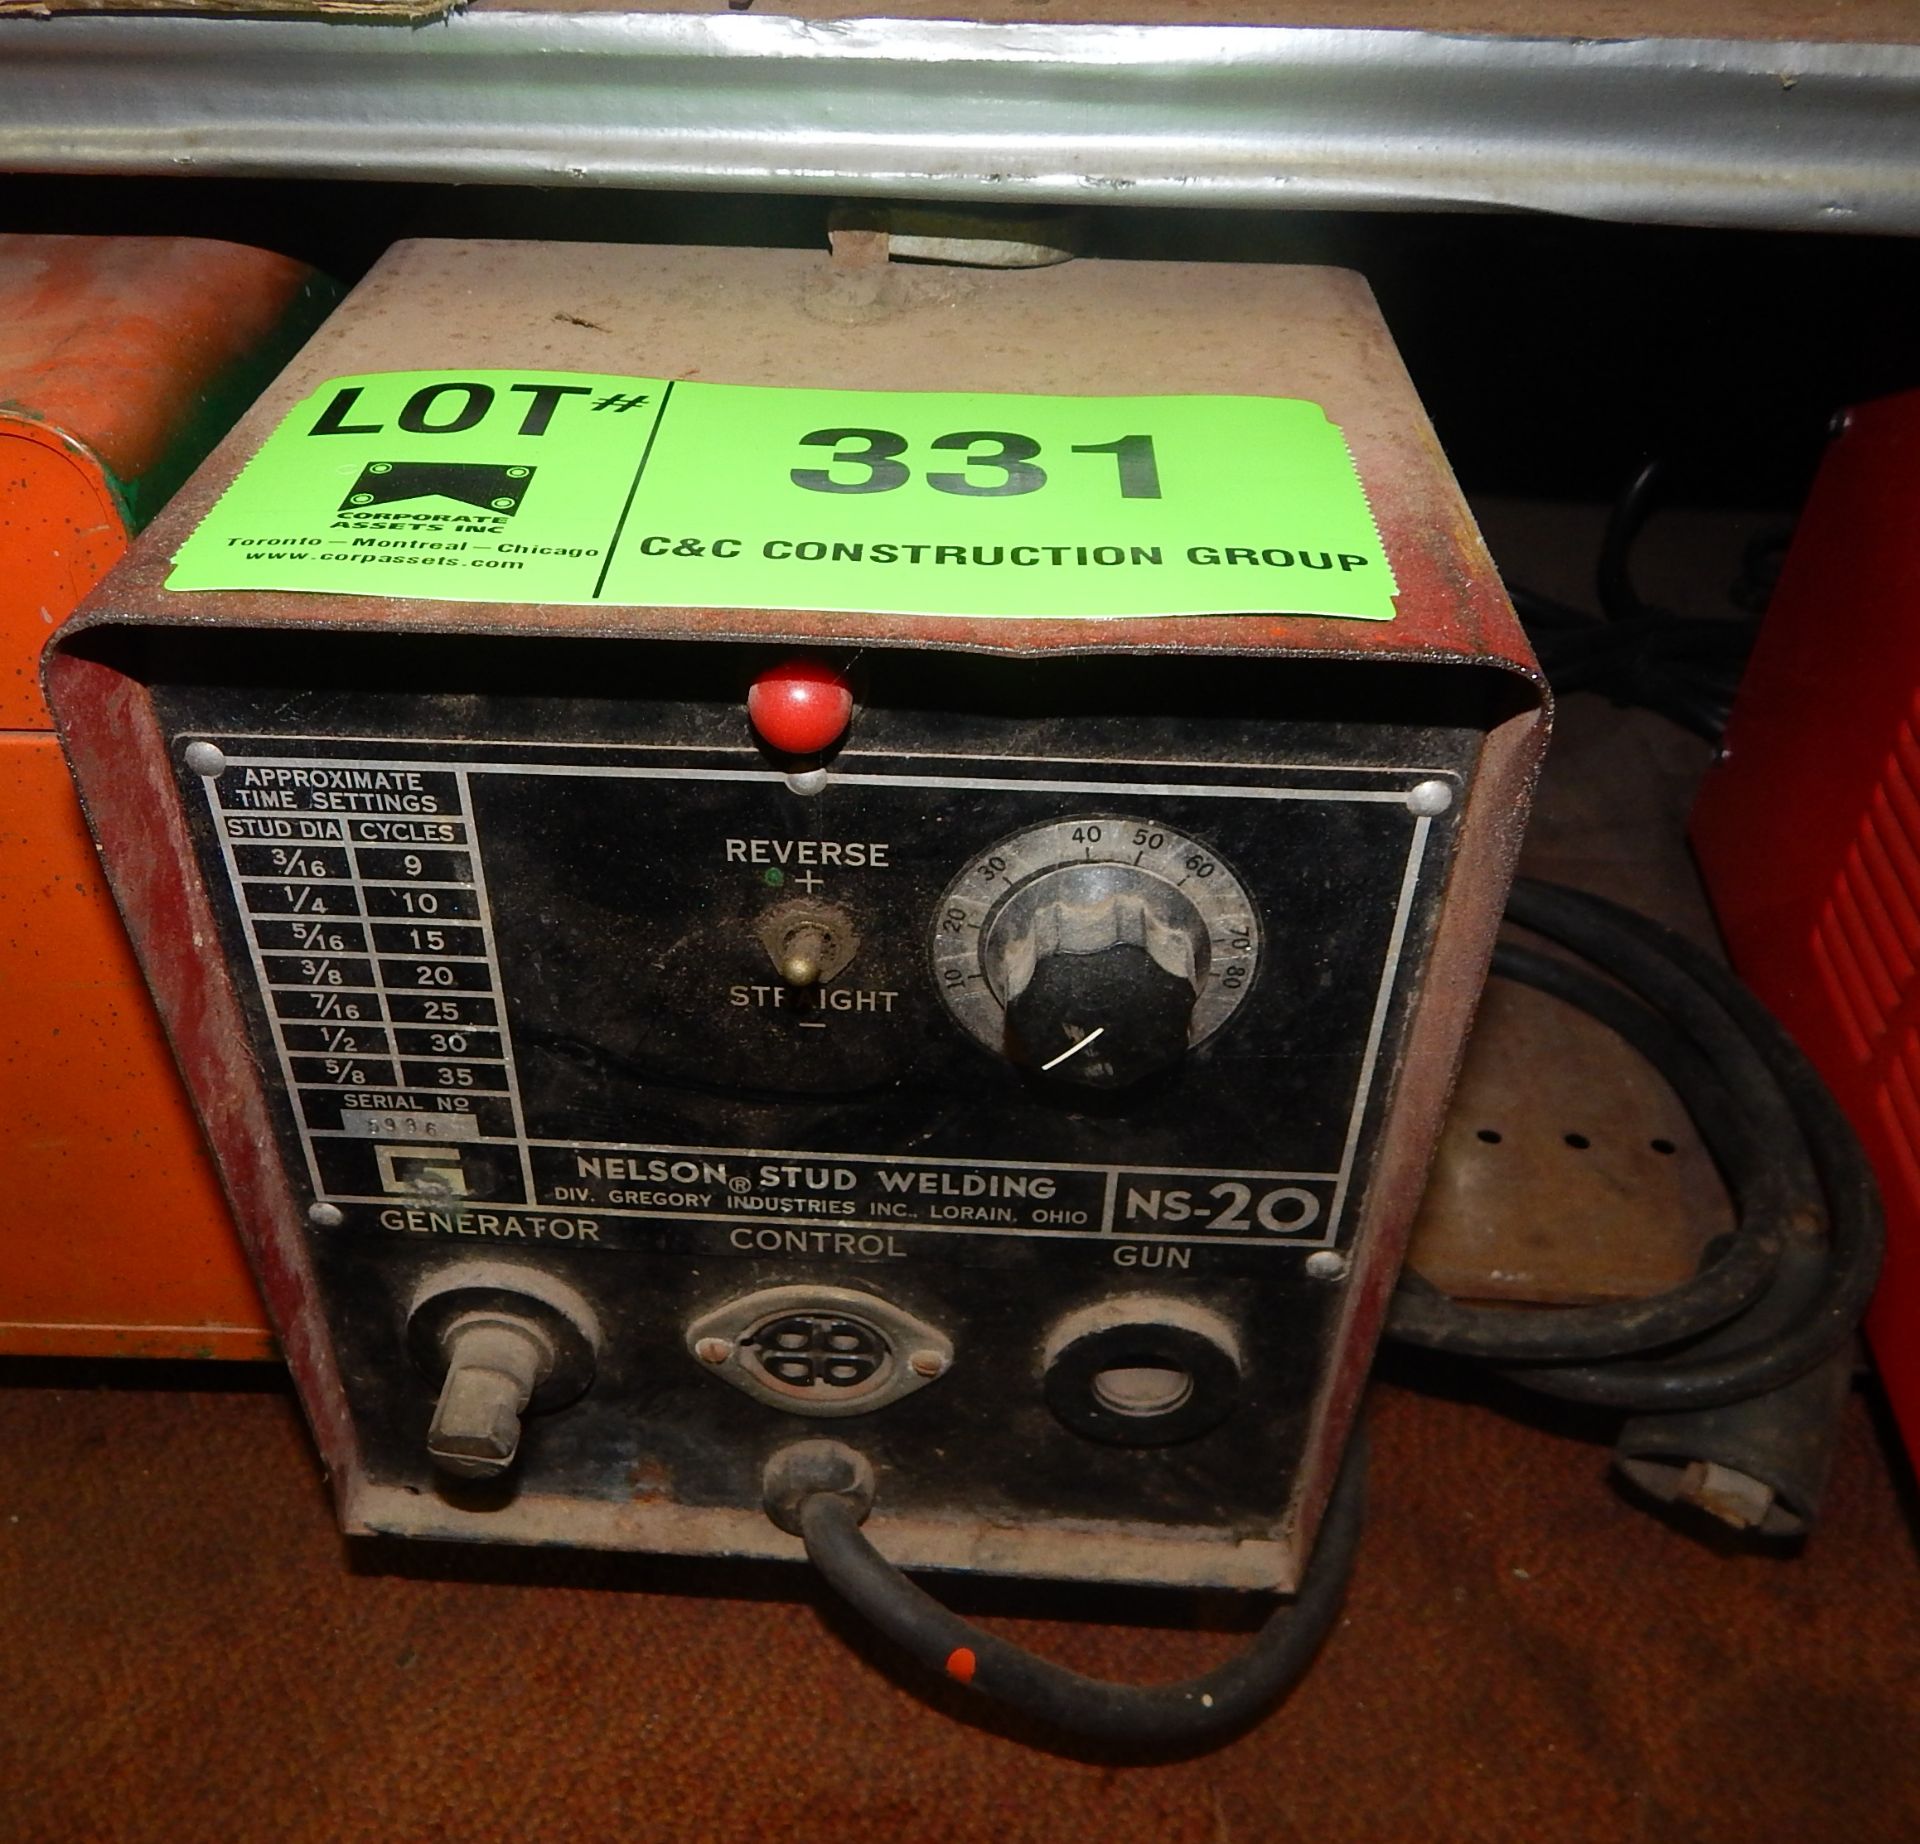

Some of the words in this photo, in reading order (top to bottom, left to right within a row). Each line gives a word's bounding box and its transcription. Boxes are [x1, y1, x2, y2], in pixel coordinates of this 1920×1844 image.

[789, 427, 1163, 499] 331
[329, 520, 441, 533] ASSETS
[446, 523, 506, 534] INC
[337, 511, 508, 525] CORPORATE
[226, 537, 322, 547] Toronto
[351, 538, 468, 551] Montreal
[497, 543, 599, 558] Chicago
[639, 535, 743, 560] C&C
[762, 539, 1163, 567] CONSTRUCTION
[1186, 546, 1369, 573] GROUP
[245, 552, 525, 570] www.corpassets.com
[244, 768, 424, 792] APPROXIMATE
[235, 789, 298, 809] TIME
[311, 791, 438, 813] SETTINGS
[227, 819, 292, 838] STUD
[300, 821, 344, 839] DIA
[359, 822, 455, 842] CYCLES
[1071, 826, 1102, 844] 40
[1132, 829, 1164, 850] 50
[271, 848, 327, 878] 3/16
[725, 838, 890, 867] REVERSE
[403, 854, 423, 877] 9
[977, 856, 1007, 882] 30
[1186, 854, 1215, 880] 60
[283, 885, 329, 914] 1/4
[402, 892, 438, 914] 10
[943, 907, 966, 933] 20
[292, 923, 345, 951] 5/16
[410, 930, 445, 951] 15
[1229, 926, 1251, 950] 70
[301, 959, 343, 985] 3/8
[416, 966, 454, 986] 20
[944, 968, 966, 990] 10
[1222, 965, 1246, 990] 80
[310, 993, 360, 1019] 7/16
[423, 1001, 459, 1020] 25
[320, 1027, 358, 1053] 1/2
[430, 1032, 467, 1053] 30
[325, 1059, 366, 1084] 5/8
[437, 1067, 474, 1086] 35
[343, 1093, 424, 1111] SERIAL
[759, 1165, 858, 1191] STUD
[878, 1170, 1057, 1200] WELDING
[554, 1186, 595, 1202] DIV.
[608, 1188, 713, 1208] GREGORY
[727, 1194, 856, 1216] INDUSTRIES
[1031, 1209, 1088, 1225] OHIO
[1126, 1182, 1320, 1233] NS-20
[379, 1209, 601, 1241] GENERATOR
[730, 1227, 908, 1258] CONTROL
[1113, 1245, 1192, 1269] GUN
